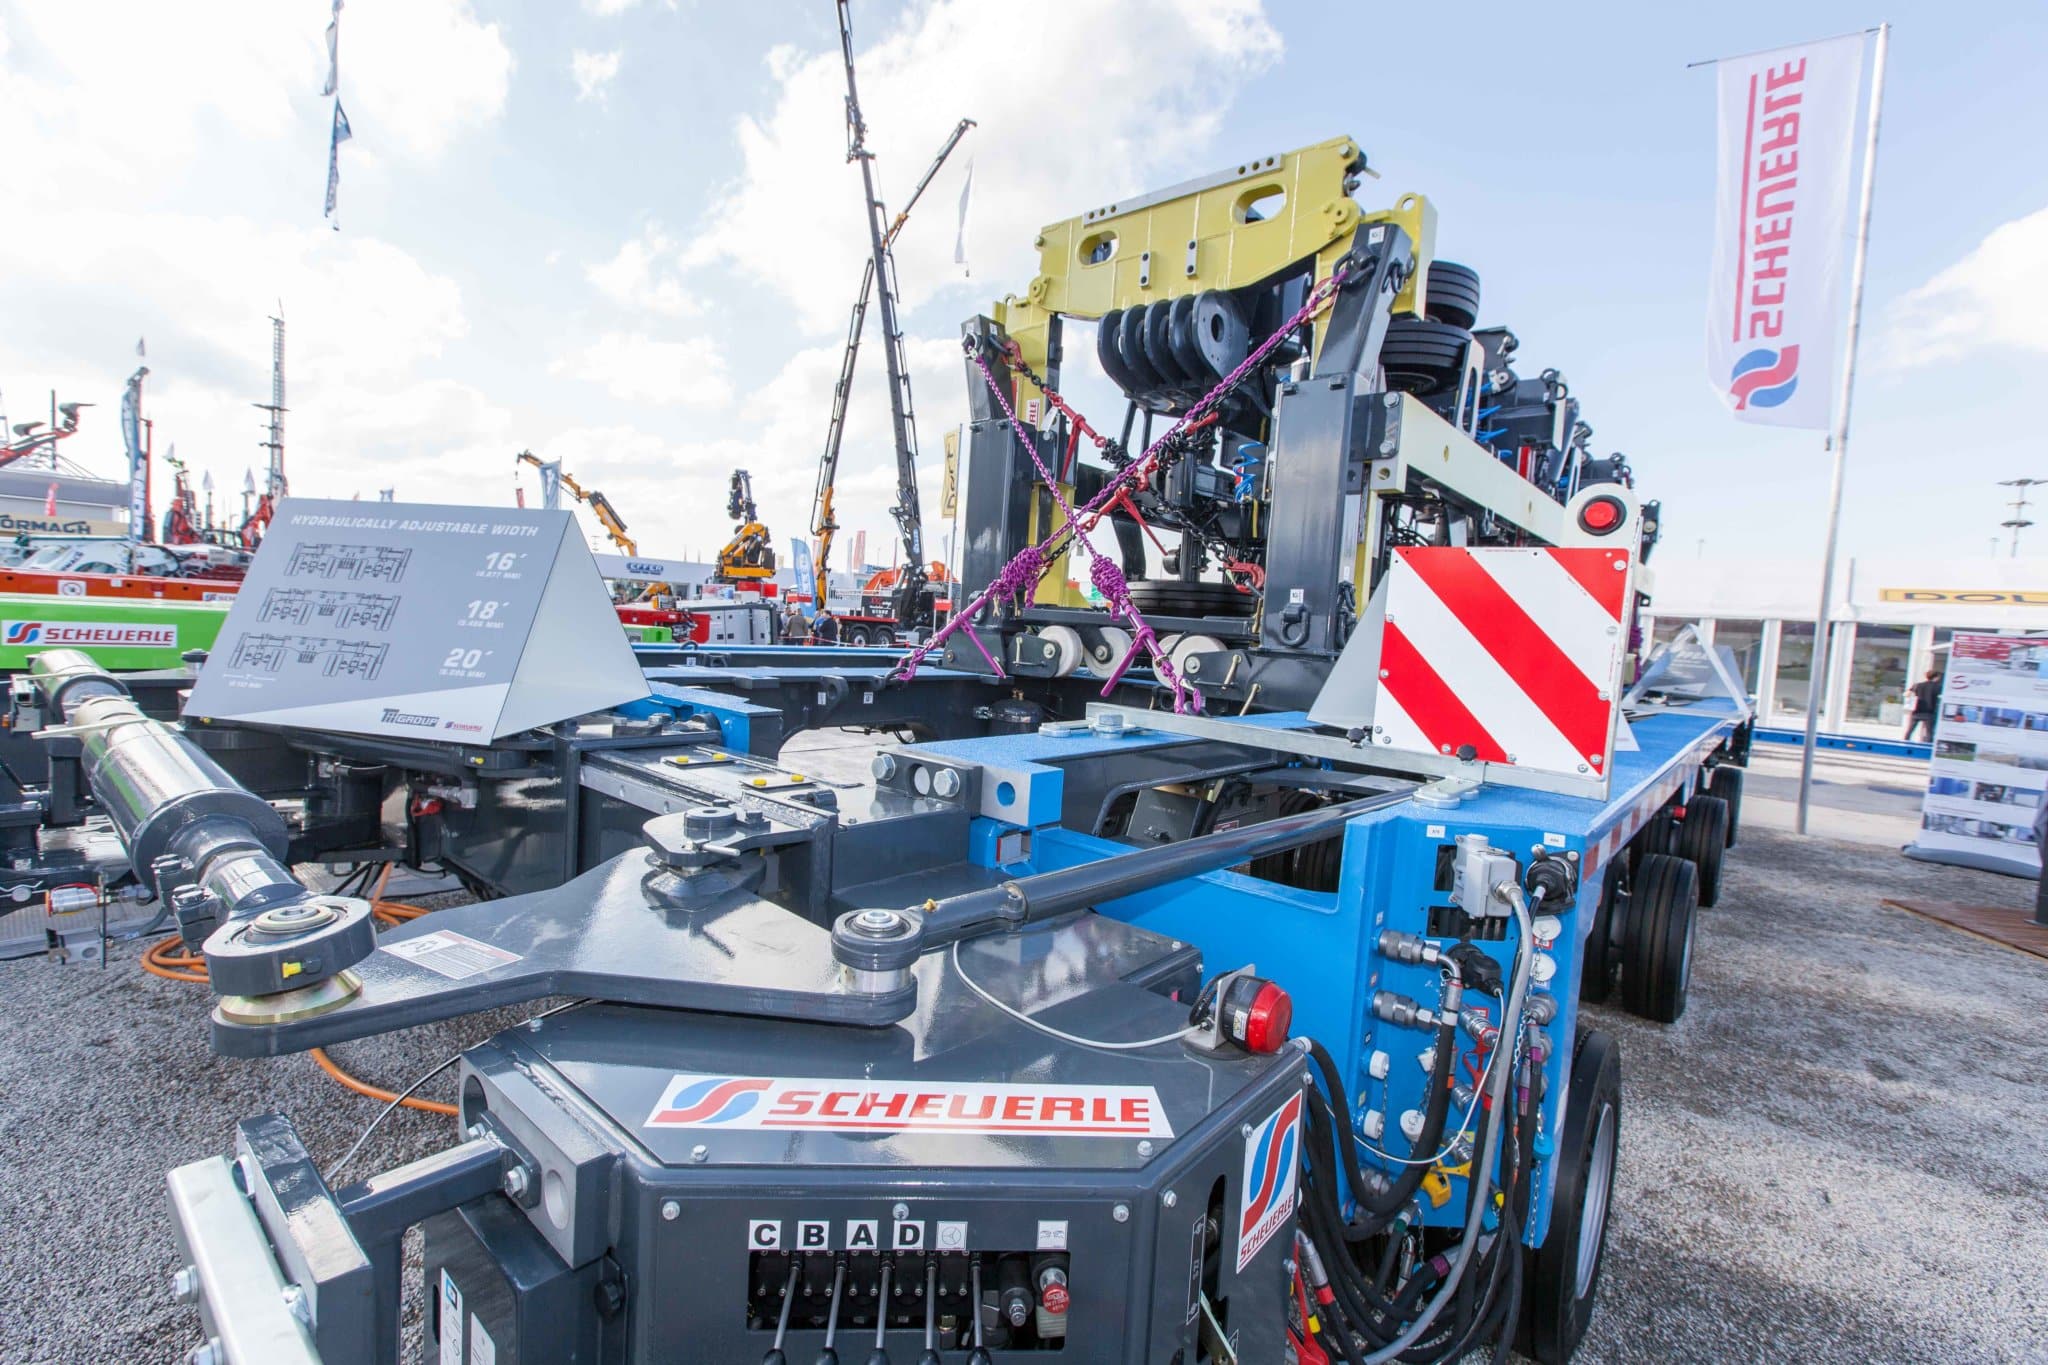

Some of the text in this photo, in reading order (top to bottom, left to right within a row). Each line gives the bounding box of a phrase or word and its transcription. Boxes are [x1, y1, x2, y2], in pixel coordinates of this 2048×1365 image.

[0, 514, 91, 534] ORMACH
[291, 514, 539, 537] HYDRAULICALLY ADJUSTABLE WIDTH
[45, 627, 175, 642] SCHEUERLE
[397, 713, 440, 728] GROUP
[767, 1089, 1152, 1123] SCHEUERLE
[754, 1224, 920, 1246] C B A D
[1239, 1195, 1294, 1262] SCHEUERLE
